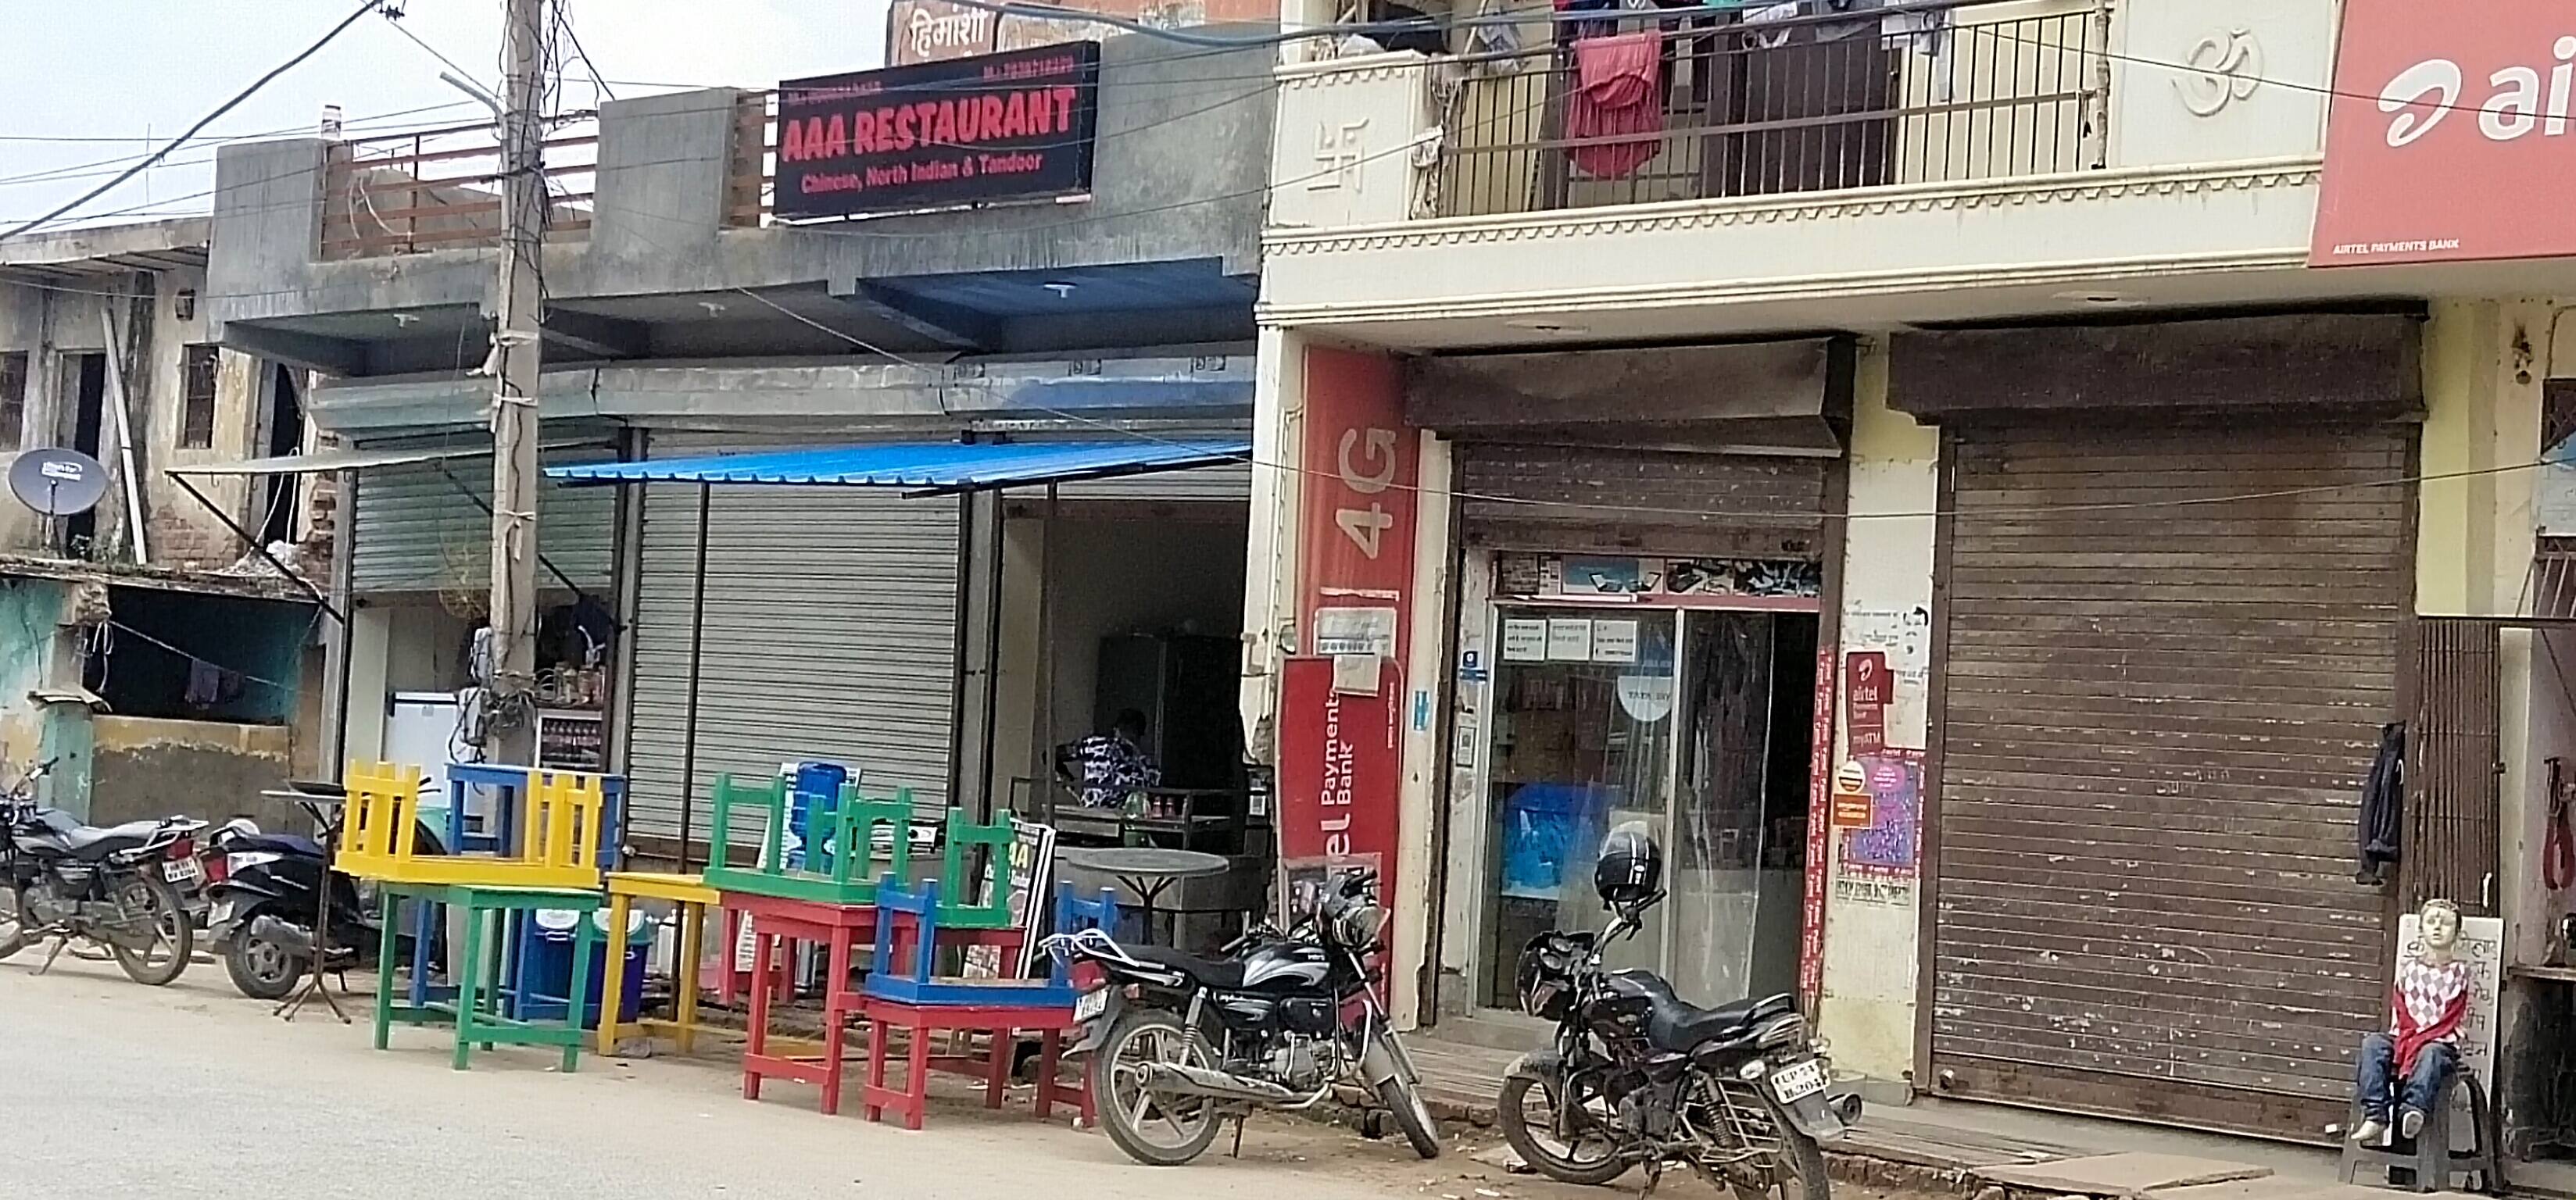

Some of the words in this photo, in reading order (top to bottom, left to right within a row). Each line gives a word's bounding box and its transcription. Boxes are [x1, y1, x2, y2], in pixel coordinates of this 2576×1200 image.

[782, 114, 846, 162] AAA
[854, 87, 1075, 155] RESTAURANT
[866, 165, 908, 187] North
[911, 160, 959, 181] Indian
[962, 156, 974, 177] &
[979, 152, 1043, 174] Tandoor
[2333, 244, 2370, 255] AIRTEL
[2371, 240, 2427, 253] PAYMENTS
[2429, 238, 2460, 251] BANK
[1335, 427, 1397, 560] 4G
[1853, 686, 1879, 702] airtel
[1336, 740, 1354, 805] Bank
